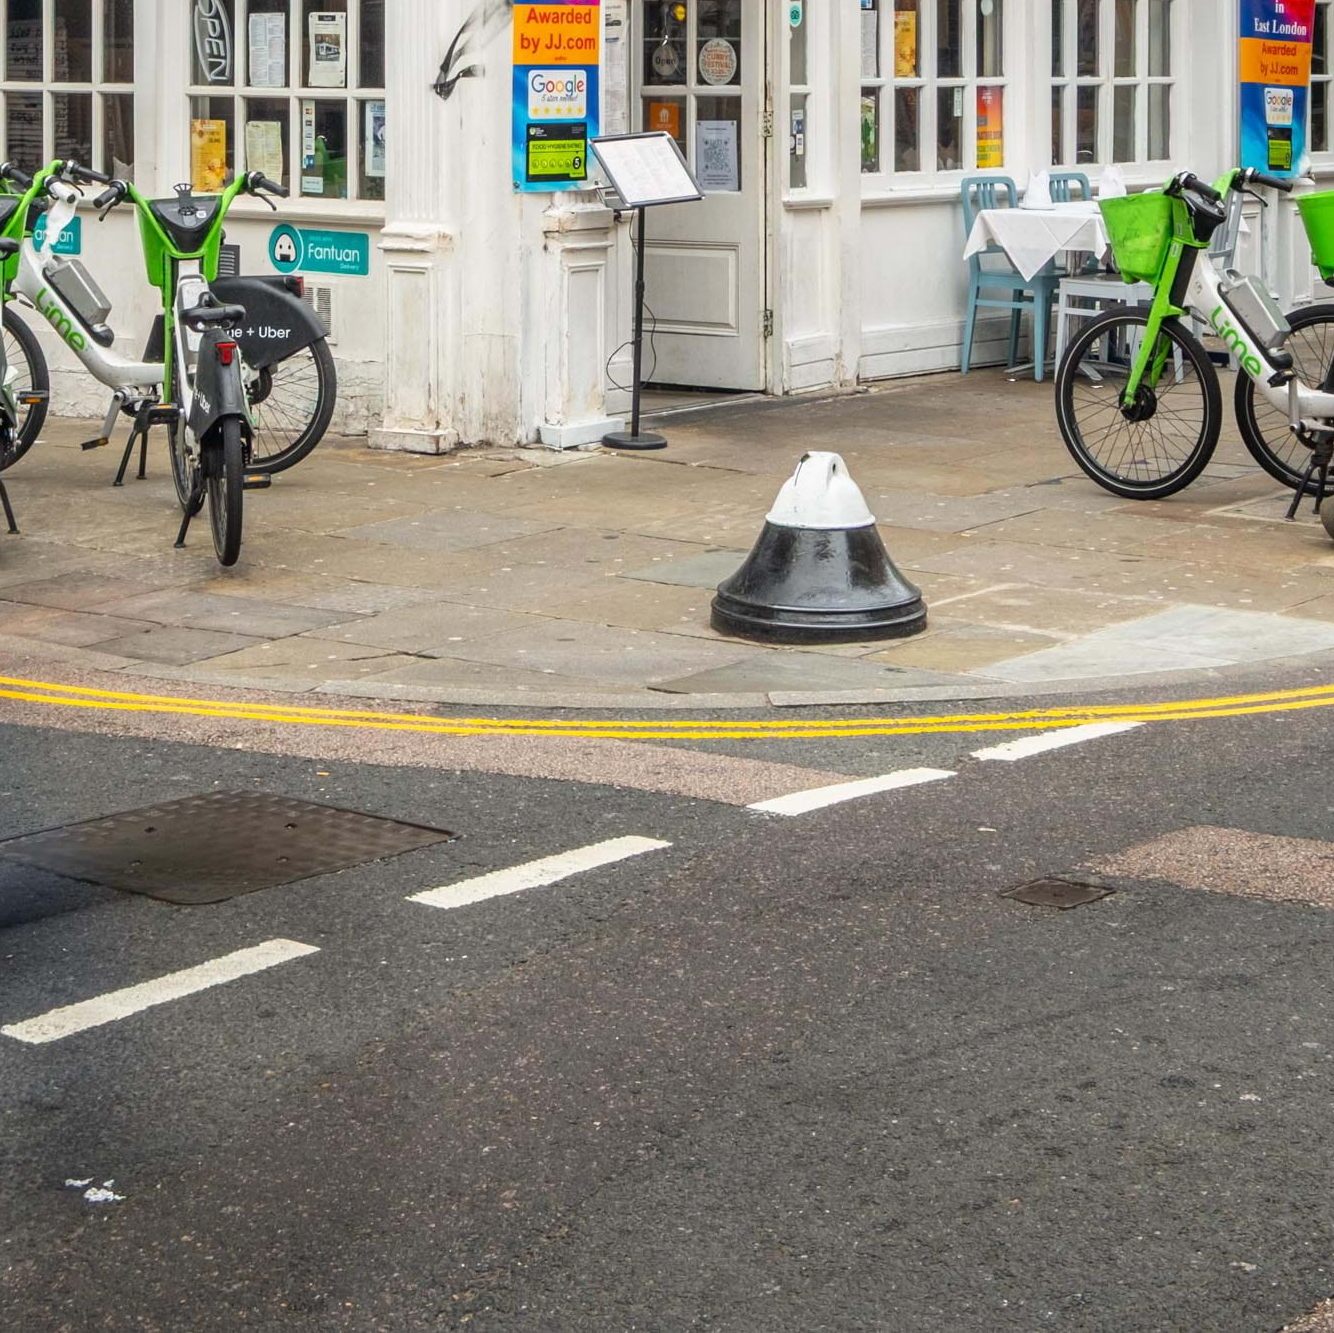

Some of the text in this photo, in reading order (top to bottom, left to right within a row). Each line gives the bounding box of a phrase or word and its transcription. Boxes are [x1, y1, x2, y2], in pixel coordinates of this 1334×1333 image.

[526, 7, 592, 24] Awarded
[1275, 0, 1284, 14] in
[1254, 17, 1307, 36] East London
[520, 33, 596, 54] by JJ.com
[1262, 41, 1297, 56] Awarded
[1260, 61, 1298, 75] by JJ.com
[531, 73, 584, 98] Google
[1266, 90, 1292, 107] Google
[574, 157, 581, 168] 5
[308, 243, 360, 263] Fantuan
[36, 287, 85, 352] Lime
[258, 326, 291, 339] Uber
[1211, 305, 1261, 378] Lime
